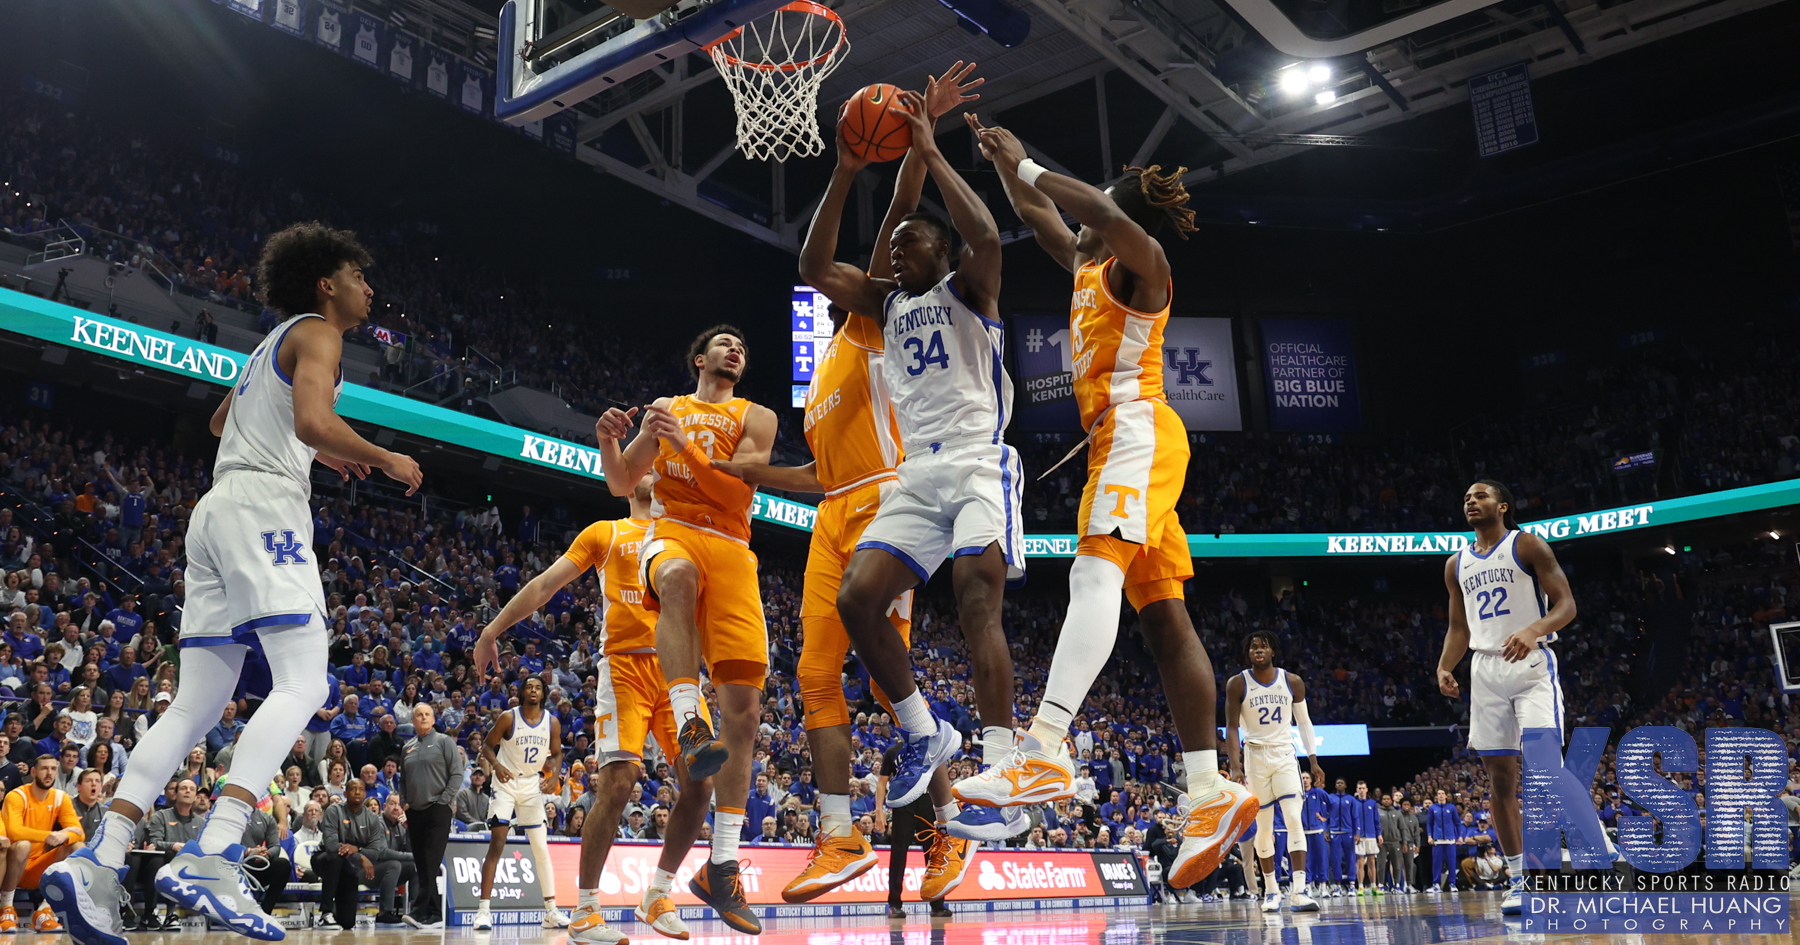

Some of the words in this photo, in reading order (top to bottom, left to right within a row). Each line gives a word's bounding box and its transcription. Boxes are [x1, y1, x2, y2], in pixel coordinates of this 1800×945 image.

[324, 21, 335, 32] 24
[361, 39, 372, 51] 00
[1472, 73, 1524, 95] CHEERLEADING
[1487, 71, 1507, 82] UCA
[1472, 80, 1527, 103] CHAMPIONSHIPS
[799, 321, 807, 329] 4
[70, 315, 238, 380] KEENELAND
[799, 345, 807, 354] 2
[904, 330, 949, 376] 34
[1269, 342, 1324, 355] OFFICIAL
[795, 356, 813, 372] T
[1163, 347, 1214, 386] UK
[1271, 354, 1348, 367] HEALTHCARE
[1273, 367, 1327, 379] PARTNER
[1329, 367, 1345, 379] OF
[1274, 379, 1302, 393] BIG
[1305, 379, 1346, 393] BLUE
[30, 386, 49, 403] 31
[1275, 394, 1339, 408] NATION
[677, 413, 738, 437] ENNESSEE
[1104, 484, 1140, 519] T
[1575, 505, 1653, 535] MEET
[261, 529, 308, 566] UK
[1327, 533, 1468, 554] KEENELAND
[1463, 568, 1514, 595] KENTUCKY
[1476, 587, 1511, 620] 22
[1249, 694, 1289, 708] KENTUCKY
[1258, 706, 1282, 725] 24
[515, 735, 548, 747] KENTUCKY
[524, 747, 539, 764] 12
[453, 852, 535, 884] DRKE'S
[1100, 861, 1136, 880] DRAKE'S
[472, 886, 497, 897] Coe
[499, 886, 525, 900] play.
[776, 906, 801, 917] KENTUCKY
[802, 906, 815, 916] FARM
[816, 905, 834, 916] BUREAU
[840, 905, 849, 915] BIG
[850, 905, 856, 915] ON
[857, 904, 886, 915] COMMITMENT
[916, 904, 926, 914] FARM
[956, 903, 962, 911] ON
[963, 902, 987, 911] COMMITMENT
[993, 902, 1011, 911] KENTUCKY
[1012, 902, 1021, 910] FARM
[1022, 901, 1035, 910] BUREAU
[1052, 899, 1073, 908] COMMITMENT
[501, 911, 518, 923] FARM
[520, 911, 546, 923] BUREAU
[682, 908, 704, 919] BUREAU
